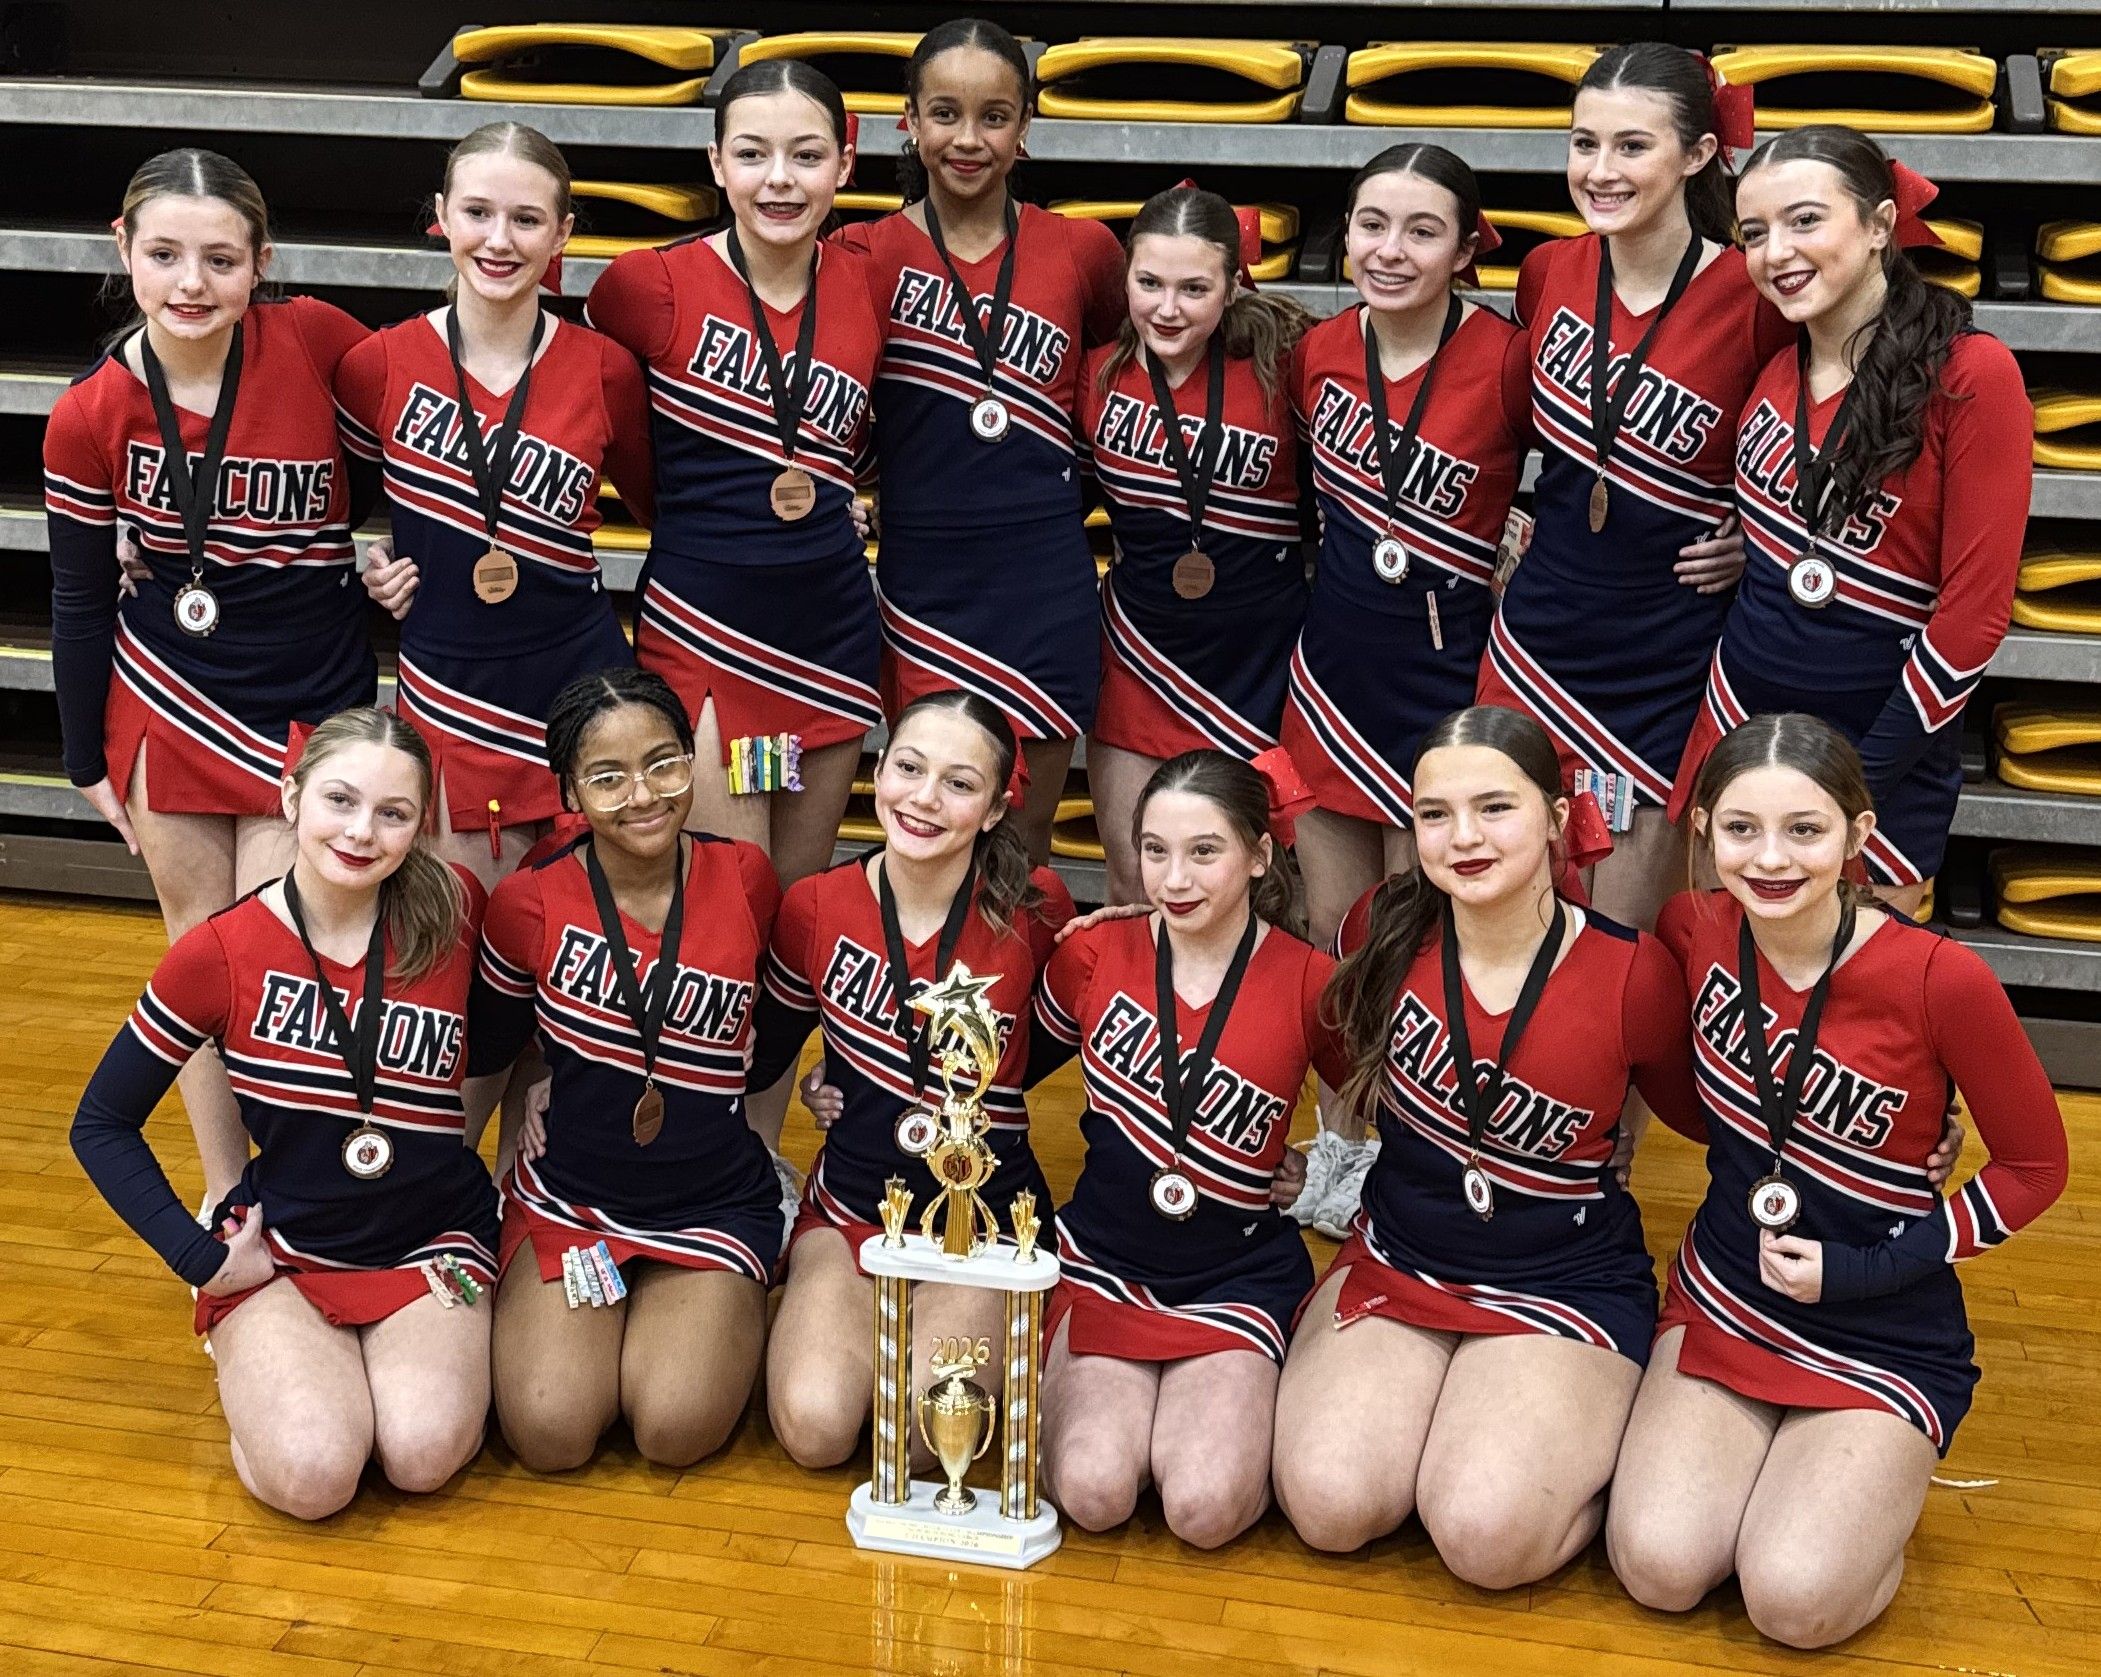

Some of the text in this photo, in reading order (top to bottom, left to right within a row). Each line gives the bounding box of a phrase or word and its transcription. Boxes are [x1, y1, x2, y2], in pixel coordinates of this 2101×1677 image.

[687, 313, 869, 446] FALONS
[125, 439, 334, 524] FACONS
[392, 382, 595, 527] FALONS
[1310, 378, 1480, 519] FALCNS
[1736, 397, 1902, 554] FALCS
[250, 969, 464, 1082] FALONS
[547, 924, 755, 1046] FALONS
[821, 934, 1017, 1074] FALC
[1088, 990, 1289, 1158] FALONS
[929, 1336, 991, 1366] 2026
